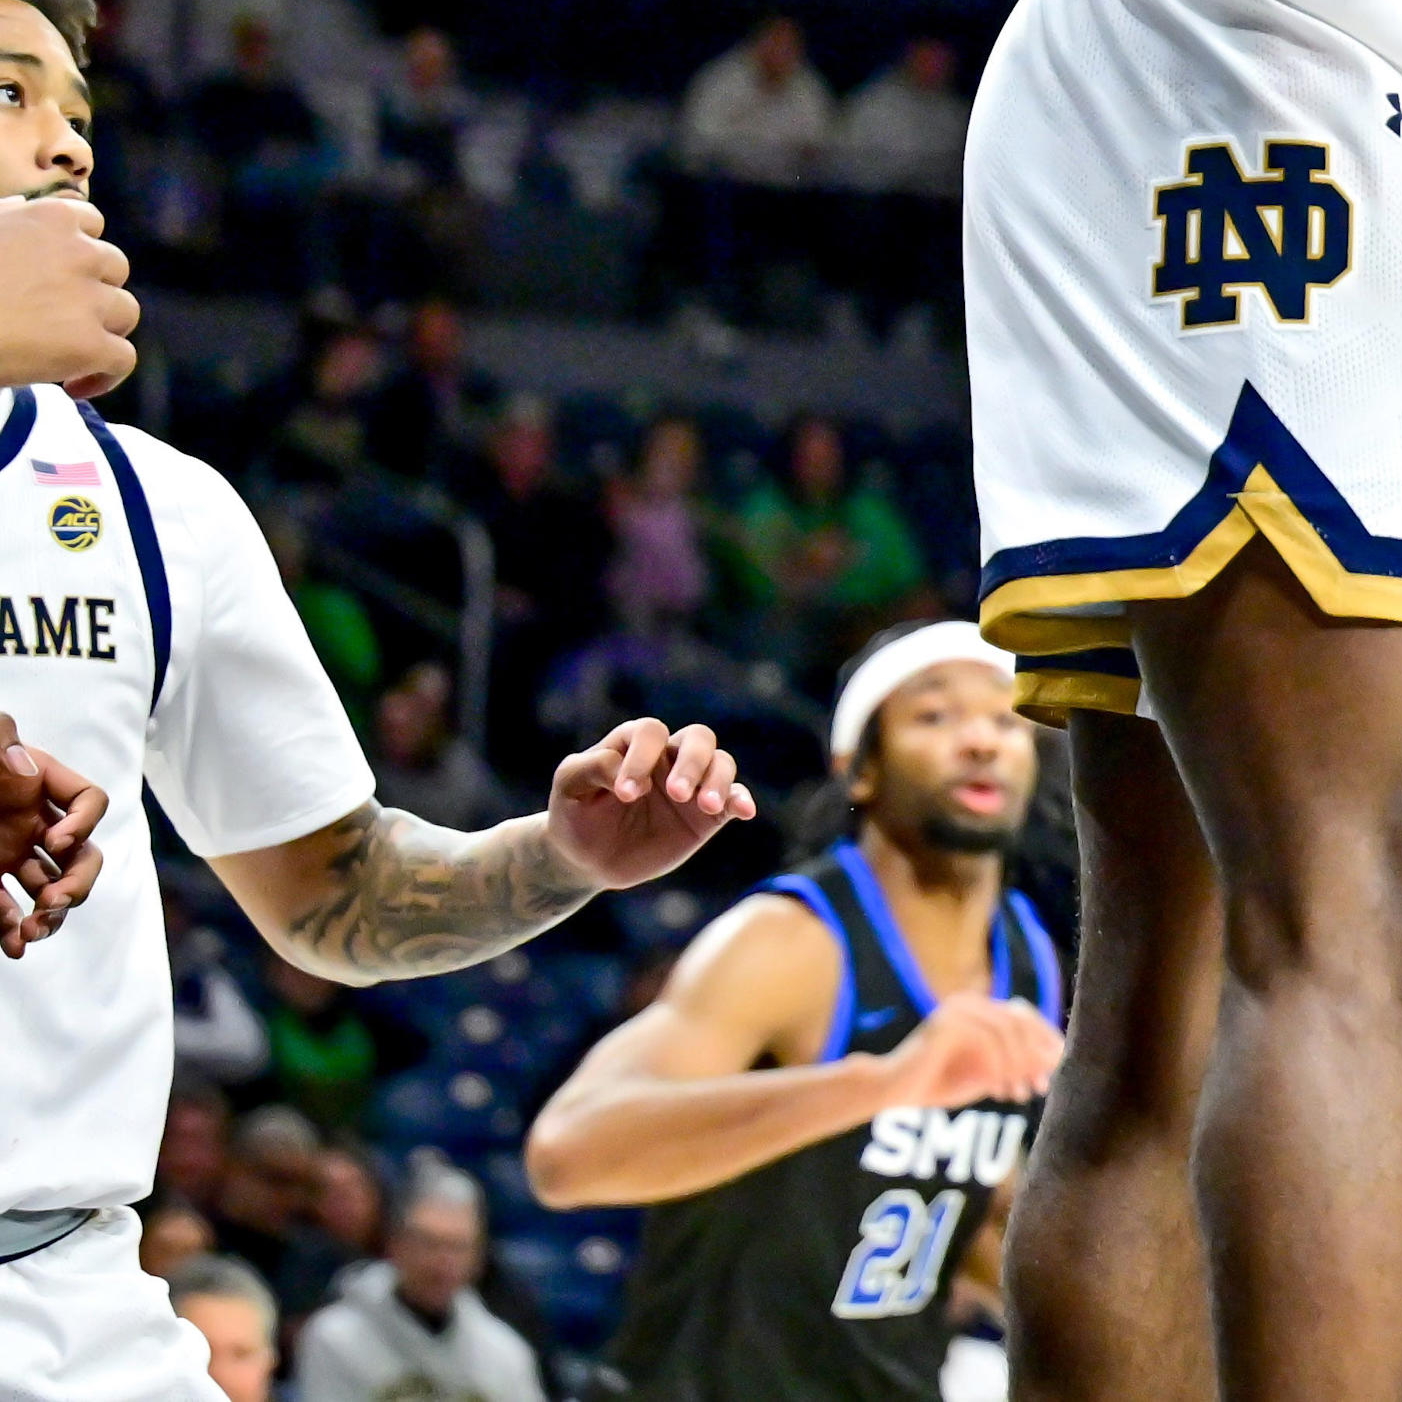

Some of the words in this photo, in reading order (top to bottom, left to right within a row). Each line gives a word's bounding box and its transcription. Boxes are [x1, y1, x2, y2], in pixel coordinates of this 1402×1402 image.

[0, 595, 118, 663] AME
[859, 1104, 1029, 1188] SMU
[830, 1187, 967, 1320] 21
